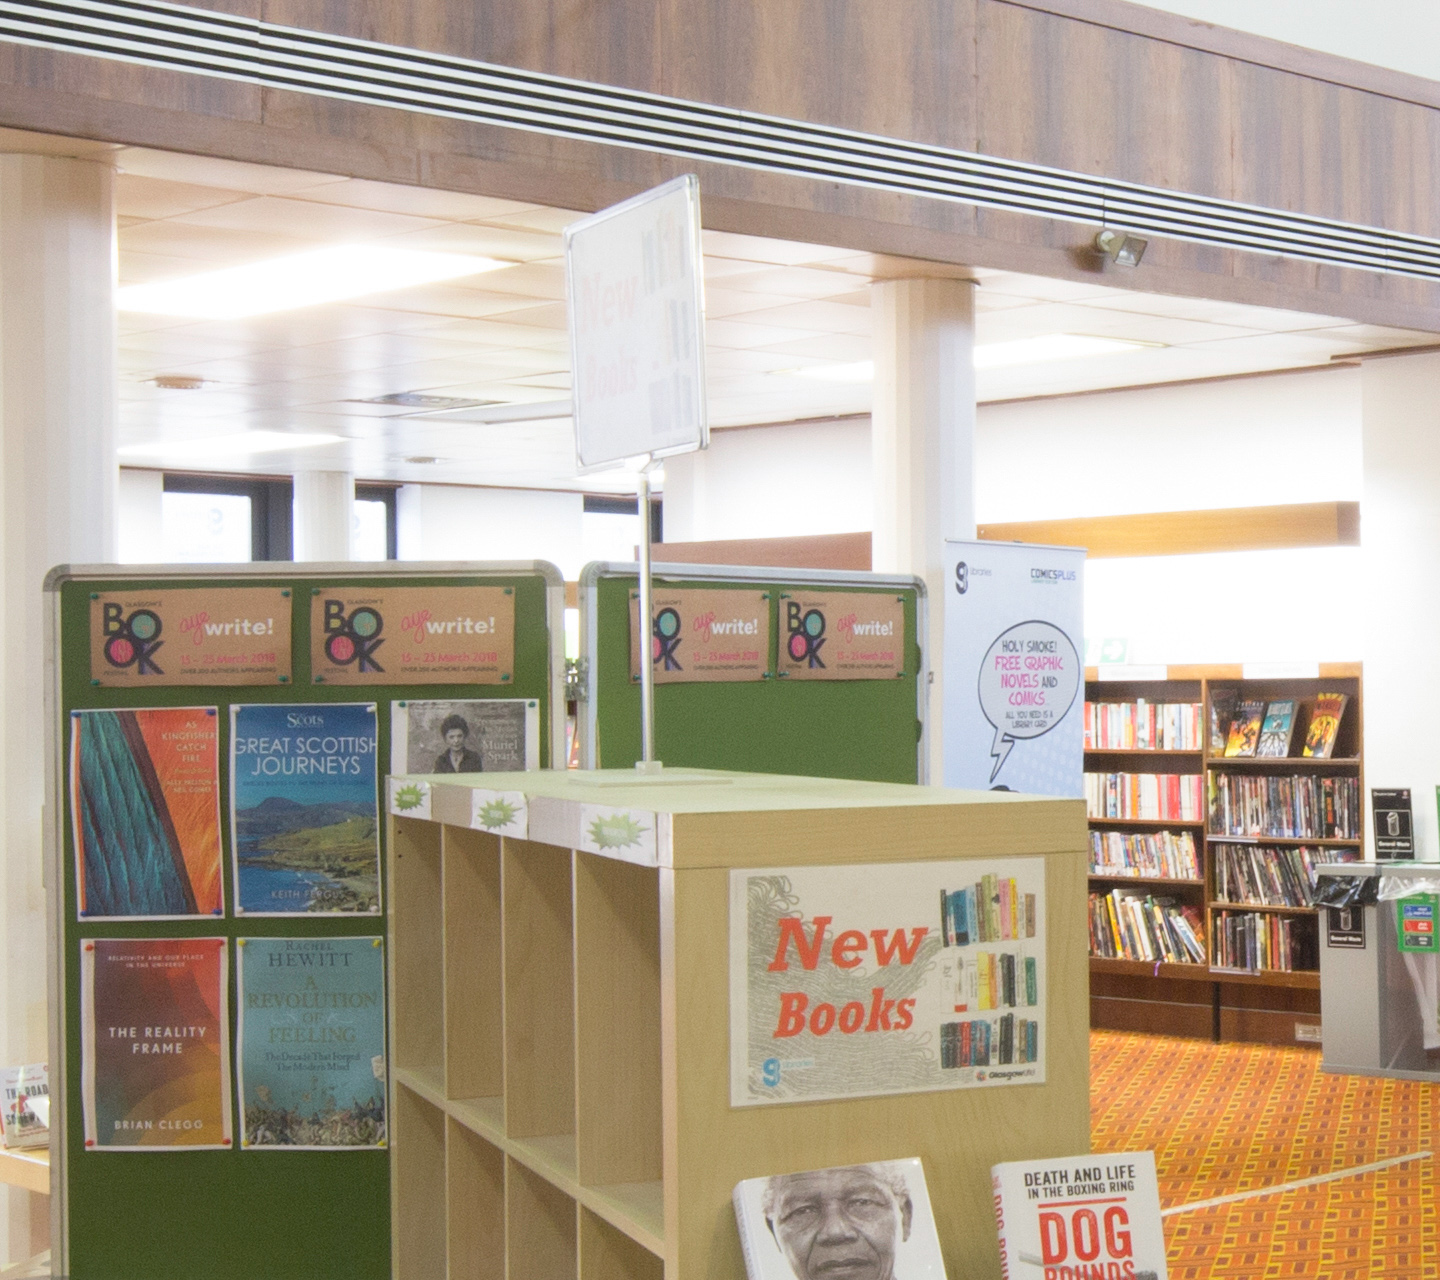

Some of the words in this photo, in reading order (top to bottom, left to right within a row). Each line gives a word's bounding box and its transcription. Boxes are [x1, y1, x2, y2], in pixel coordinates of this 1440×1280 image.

[205, 618, 274, 636] write!
[426, 616, 496, 635] write!
[710, 619, 758, 636] write!
[852, 620, 894, 637] write!
[1002, 641, 1023, 653] HOLY
[1026, 640, 1058, 653] SMOKE!
[994, 655, 1021, 671] FREE
[1024, 656, 1064, 671] GRAPHIC
[1001, 673, 1039, 689] NOVELS
[1041, 676, 1058, 688] AND
[235, 737, 291, 754] GREAT
[251, 756, 361, 775] JOURNEYS
[271, 889, 300, 899] KEITH
[285, 940, 333, 952] RACHEL
[768, 916, 929, 973] New
[268, 952, 353, 968] HEWITT
[248, 991, 378, 1009] REVOLUTION
[772, 987, 916, 1038] Books
[109, 1027, 137, 1038] THE
[144, 1026, 207, 1038] REALITY
[269, 1027, 357, 1044] FEELING
[132, 1042, 183, 1055] FRAME
[114, 1120, 152, 1130] BRIAN
[1024, 1170, 1069, 1187] DEATH
[1074, 1167, 1102, 1183] AND
[1107, 1164, 1136, 1180] LIFE
[1027, 1188, 1040, 1200] IN
[1043, 1186, 1064, 1198] THE
[1067, 1183, 1106, 1196] BOXING
[1109, 1180, 1135, 1192] RING
[993, 1194, 1005, 1231] DOG
[1038, 1205, 1133, 1266] DOG
